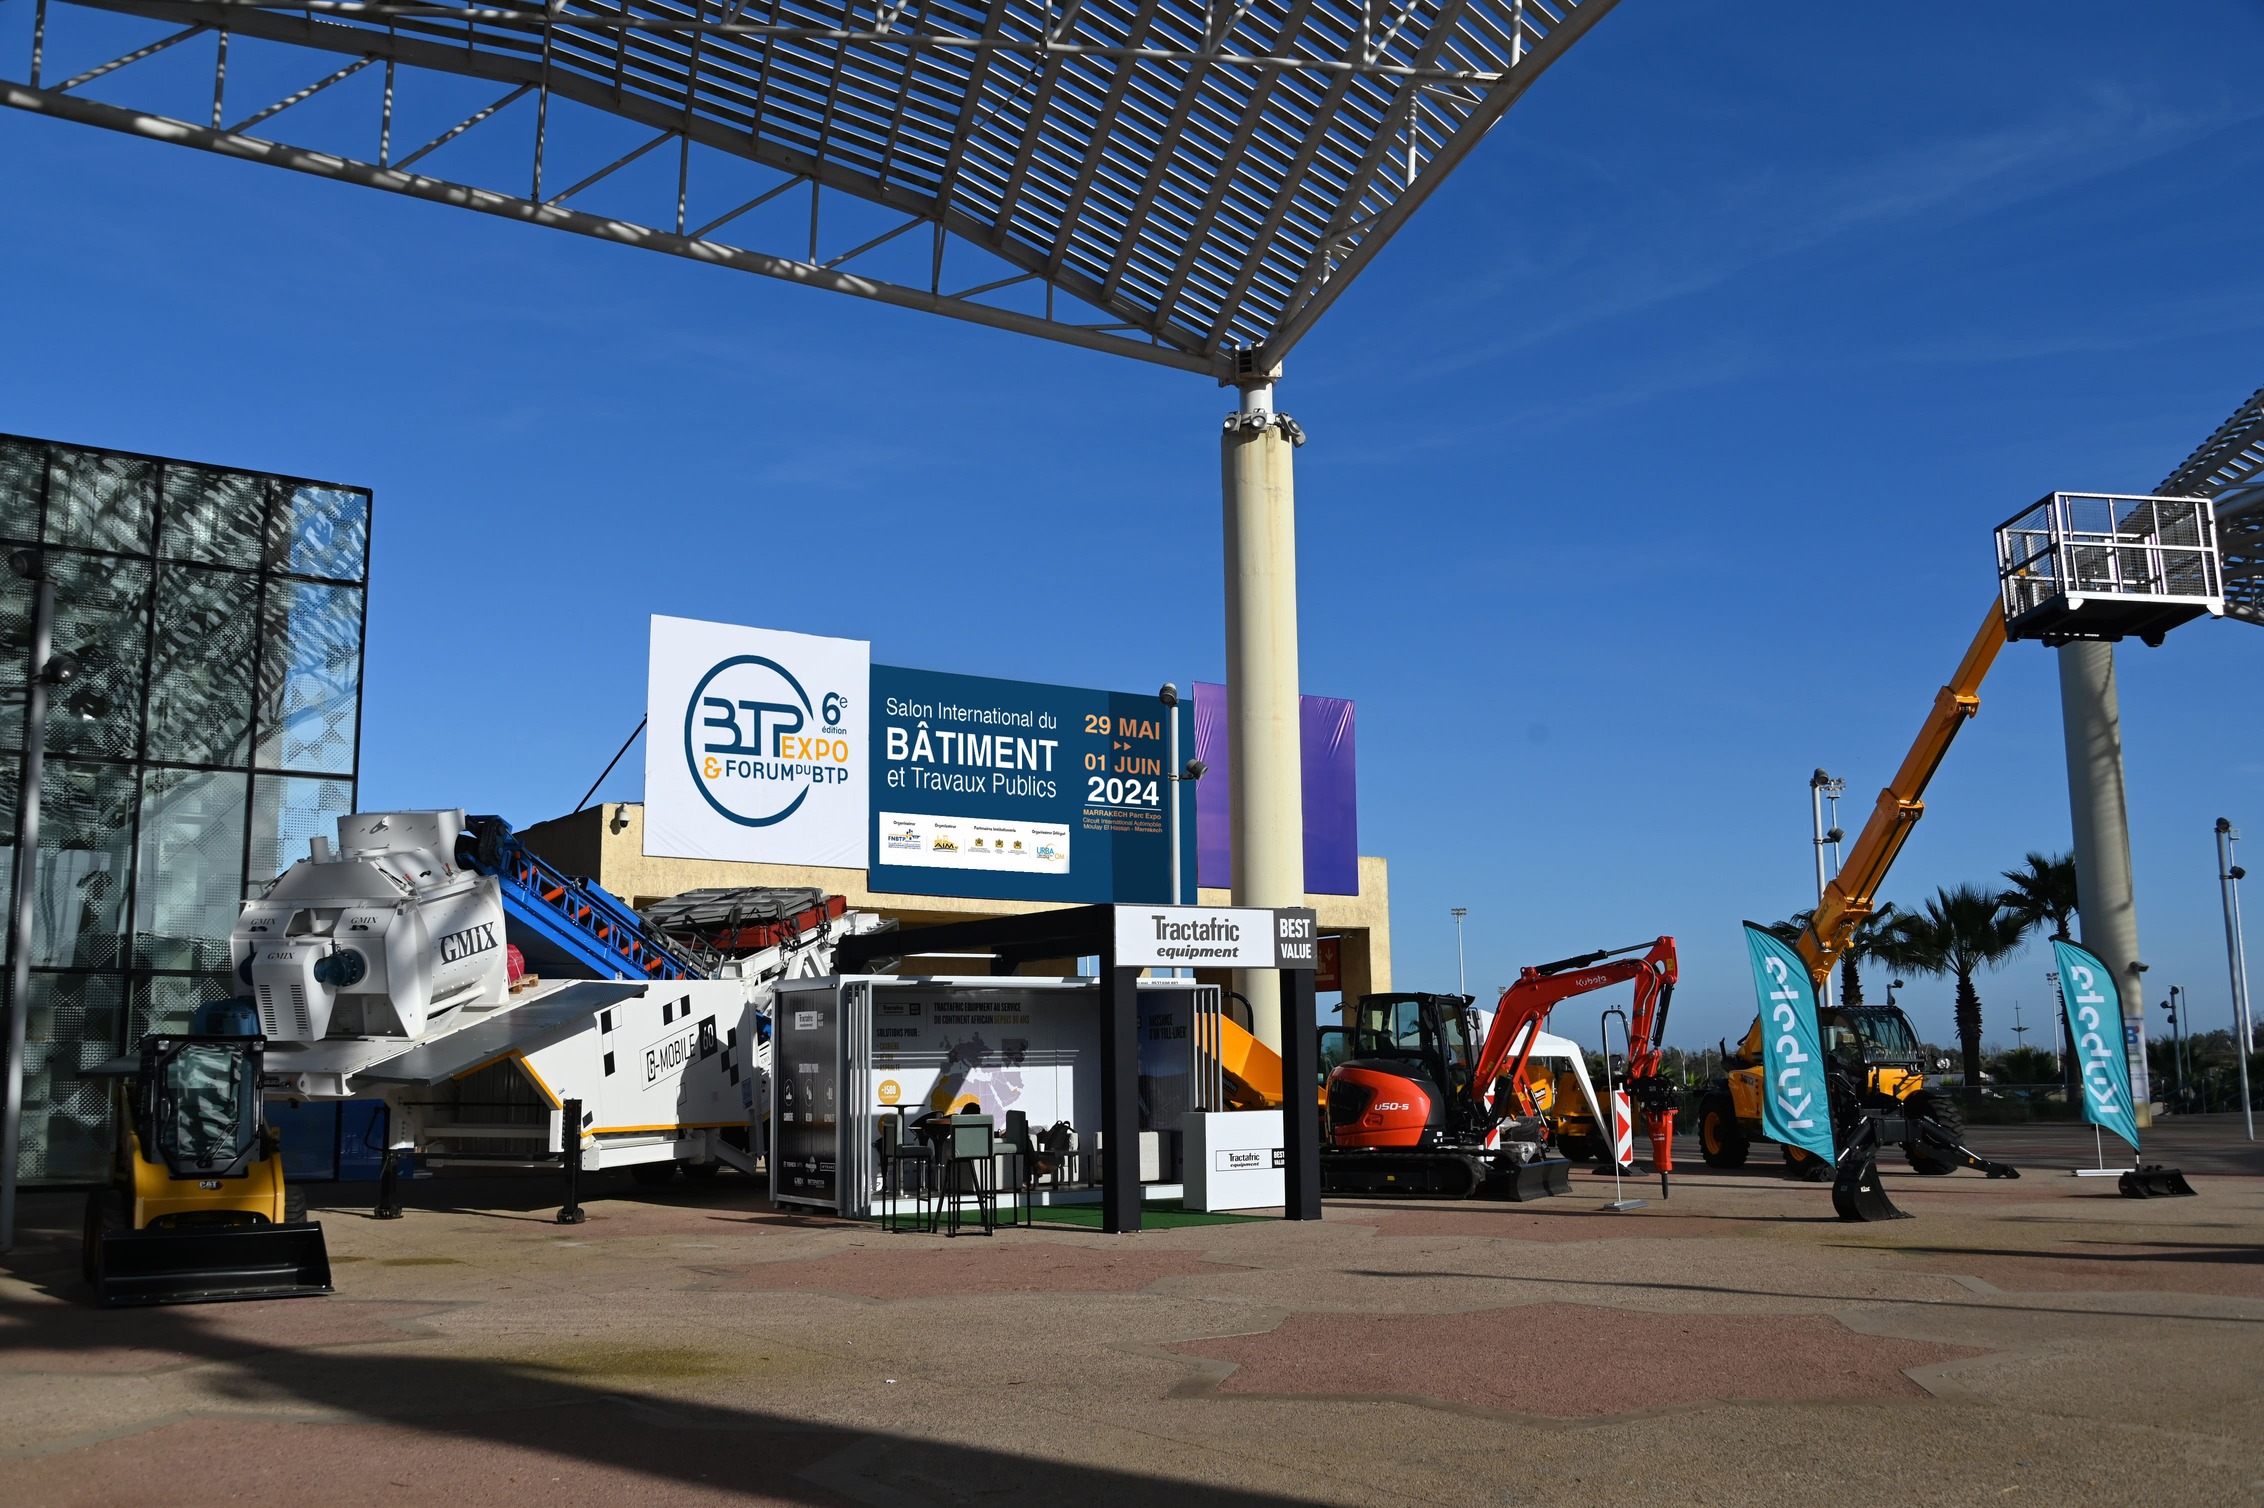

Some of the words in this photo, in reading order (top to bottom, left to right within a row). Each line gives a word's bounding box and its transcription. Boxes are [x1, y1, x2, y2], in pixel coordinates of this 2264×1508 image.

[886, 697, 933, 719] Salon
[938, 702, 1033, 728] International
[1038, 711, 1057, 729] du
[704, 697, 804, 757] BTP
[822, 726, 847, 734] édition
[1084, 714, 1112, 735] 29
[1119, 718, 1160, 740] MAI
[782, 736, 849, 763] EXPO
[886, 721, 1059, 772] BÂTIMENT
[704, 757, 722, 779] &
[726, 760, 794, 781] FORUM
[812, 766, 848, 784] BTP
[1084, 753, 1106, 771] 01
[1114, 756, 1160, 776] JUIN
[887, 766, 905, 788] et
[910, 767, 986, 793] Travaux
[992, 772, 1057, 798] Publics
[1087, 776, 1160, 806] 2024
[1083, 809, 1128, 818] MARRAKECH
[1145, 813, 1161, 821] Expo
[1101, 818, 1133, 826] International
[1134, 820, 1162, 828] Automobile
[1083, 823, 1103, 831] Moulay
[1152, 915, 1239, 941] Tractafric
[1280, 918, 1310, 938] BEST
[438, 921, 498, 965] GMIX
[1281, 943, 1311, 959] VALUE
[267, 952, 294, 960] GMIX
[1157, 945, 1239, 960] equipment
[1576, 975, 1607, 986] Kubota
[934, 1002, 964, 1012] TRACTAFRIC
[965, 1002, 993, 1012] EQUIPMENT
[1001, 1002, 1021, 1012] SERVICE
[942, 1015, 970, 1025] CONTINENT
[971, 1015, 993, 1025] AFRICAIN
[877, 1028, 903, 1037] SOLUTIONS
[646, 1033, 696, 1082] G-MOBILE
[702, 1023, 714, 1050] 60
[1229, 1152, 1260, 1162] Tractafric
[199, 1181, 217, 1189] CAT
